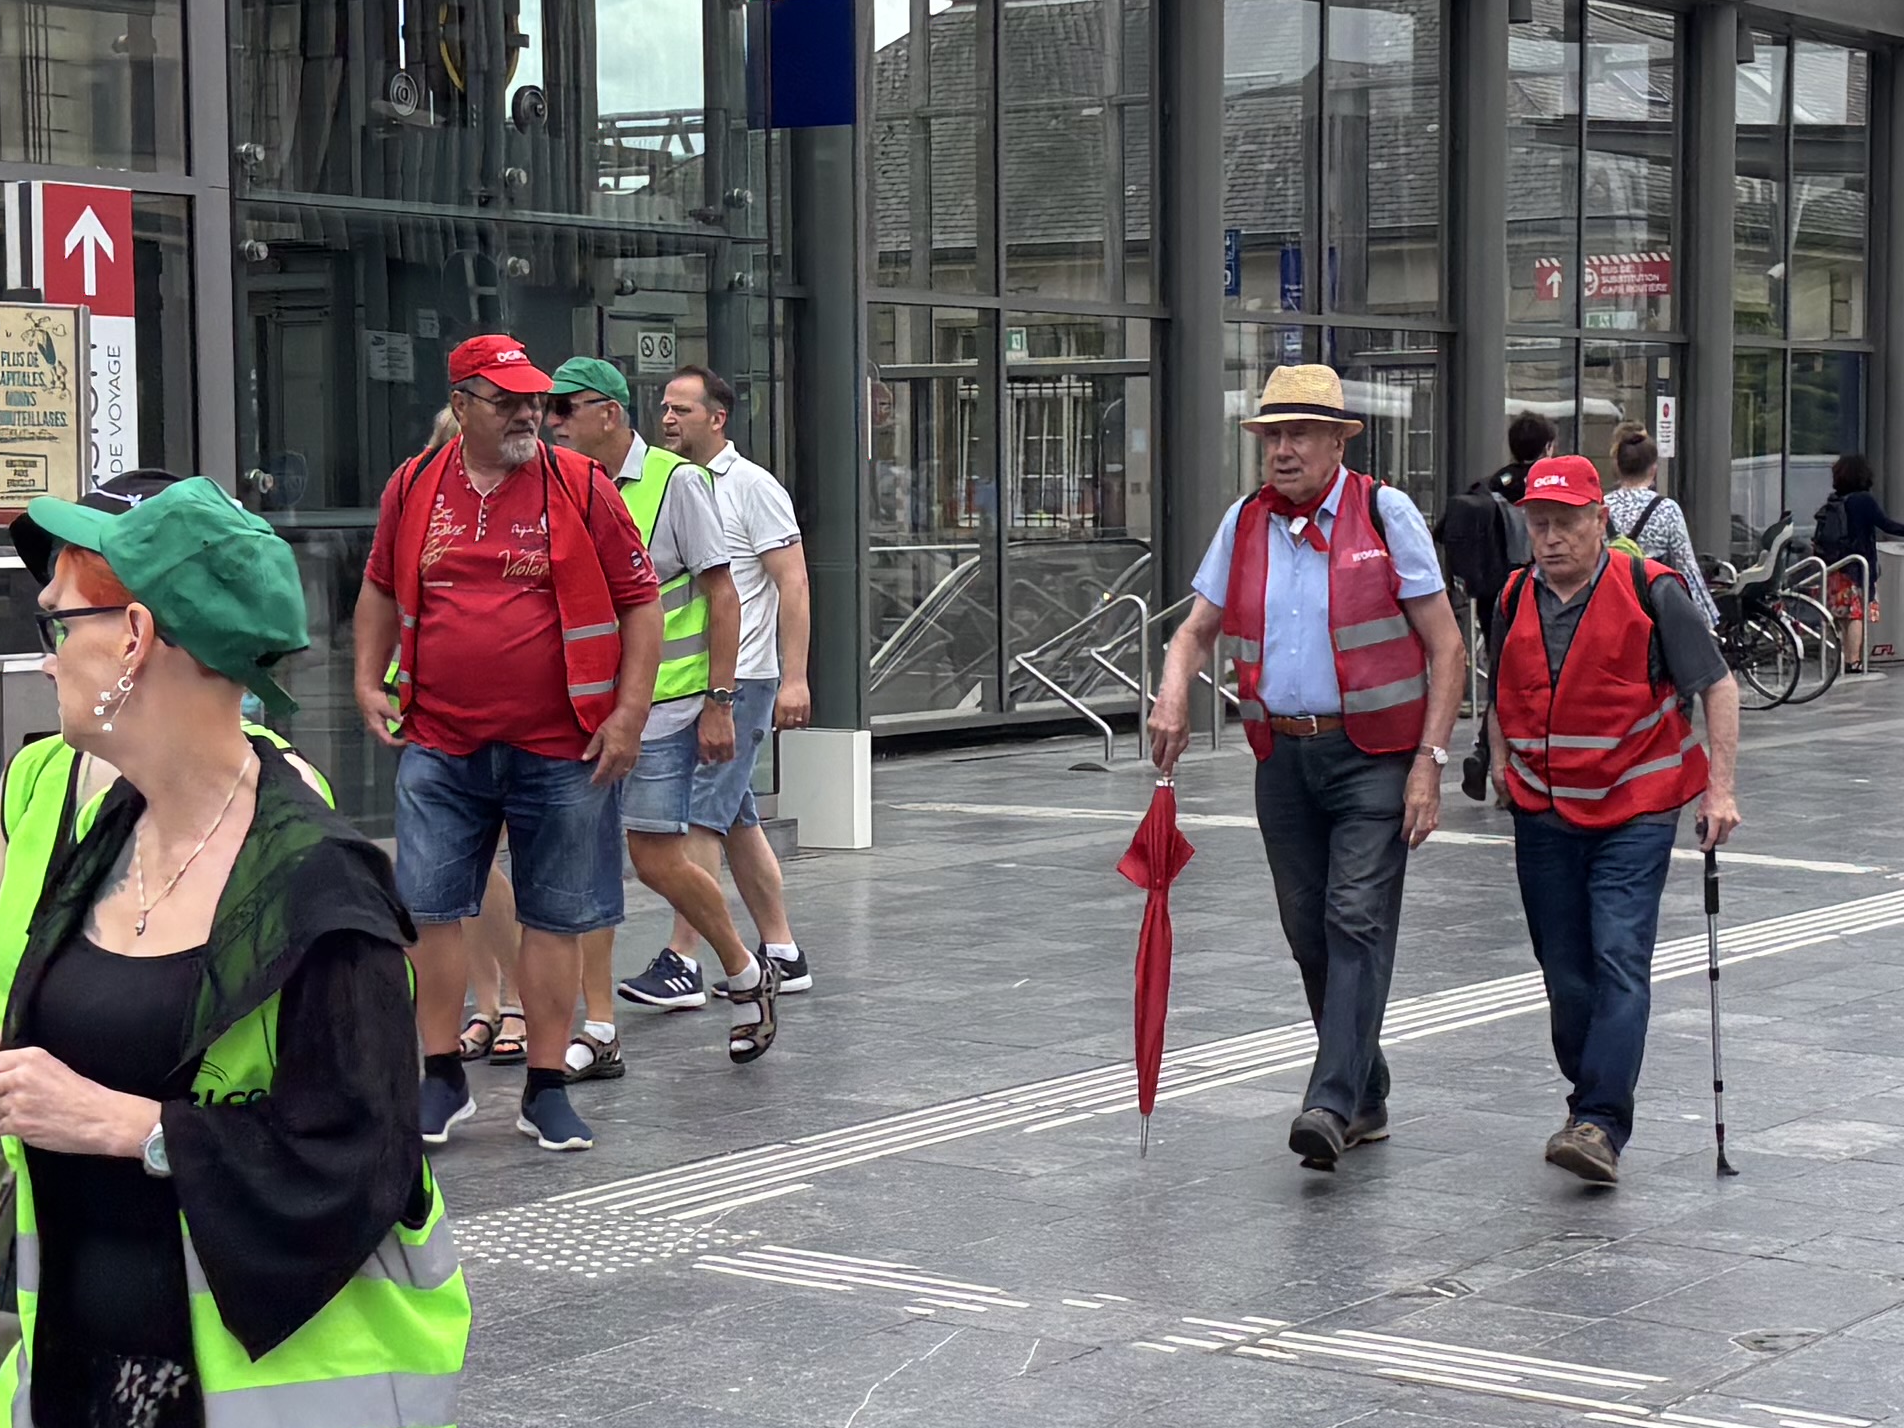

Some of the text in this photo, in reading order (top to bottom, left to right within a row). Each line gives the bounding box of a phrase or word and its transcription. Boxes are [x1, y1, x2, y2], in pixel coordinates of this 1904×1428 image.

[1, 350, 40, 368] PLUS DE
[107, 345, 124, 474] DE VOYAGE
